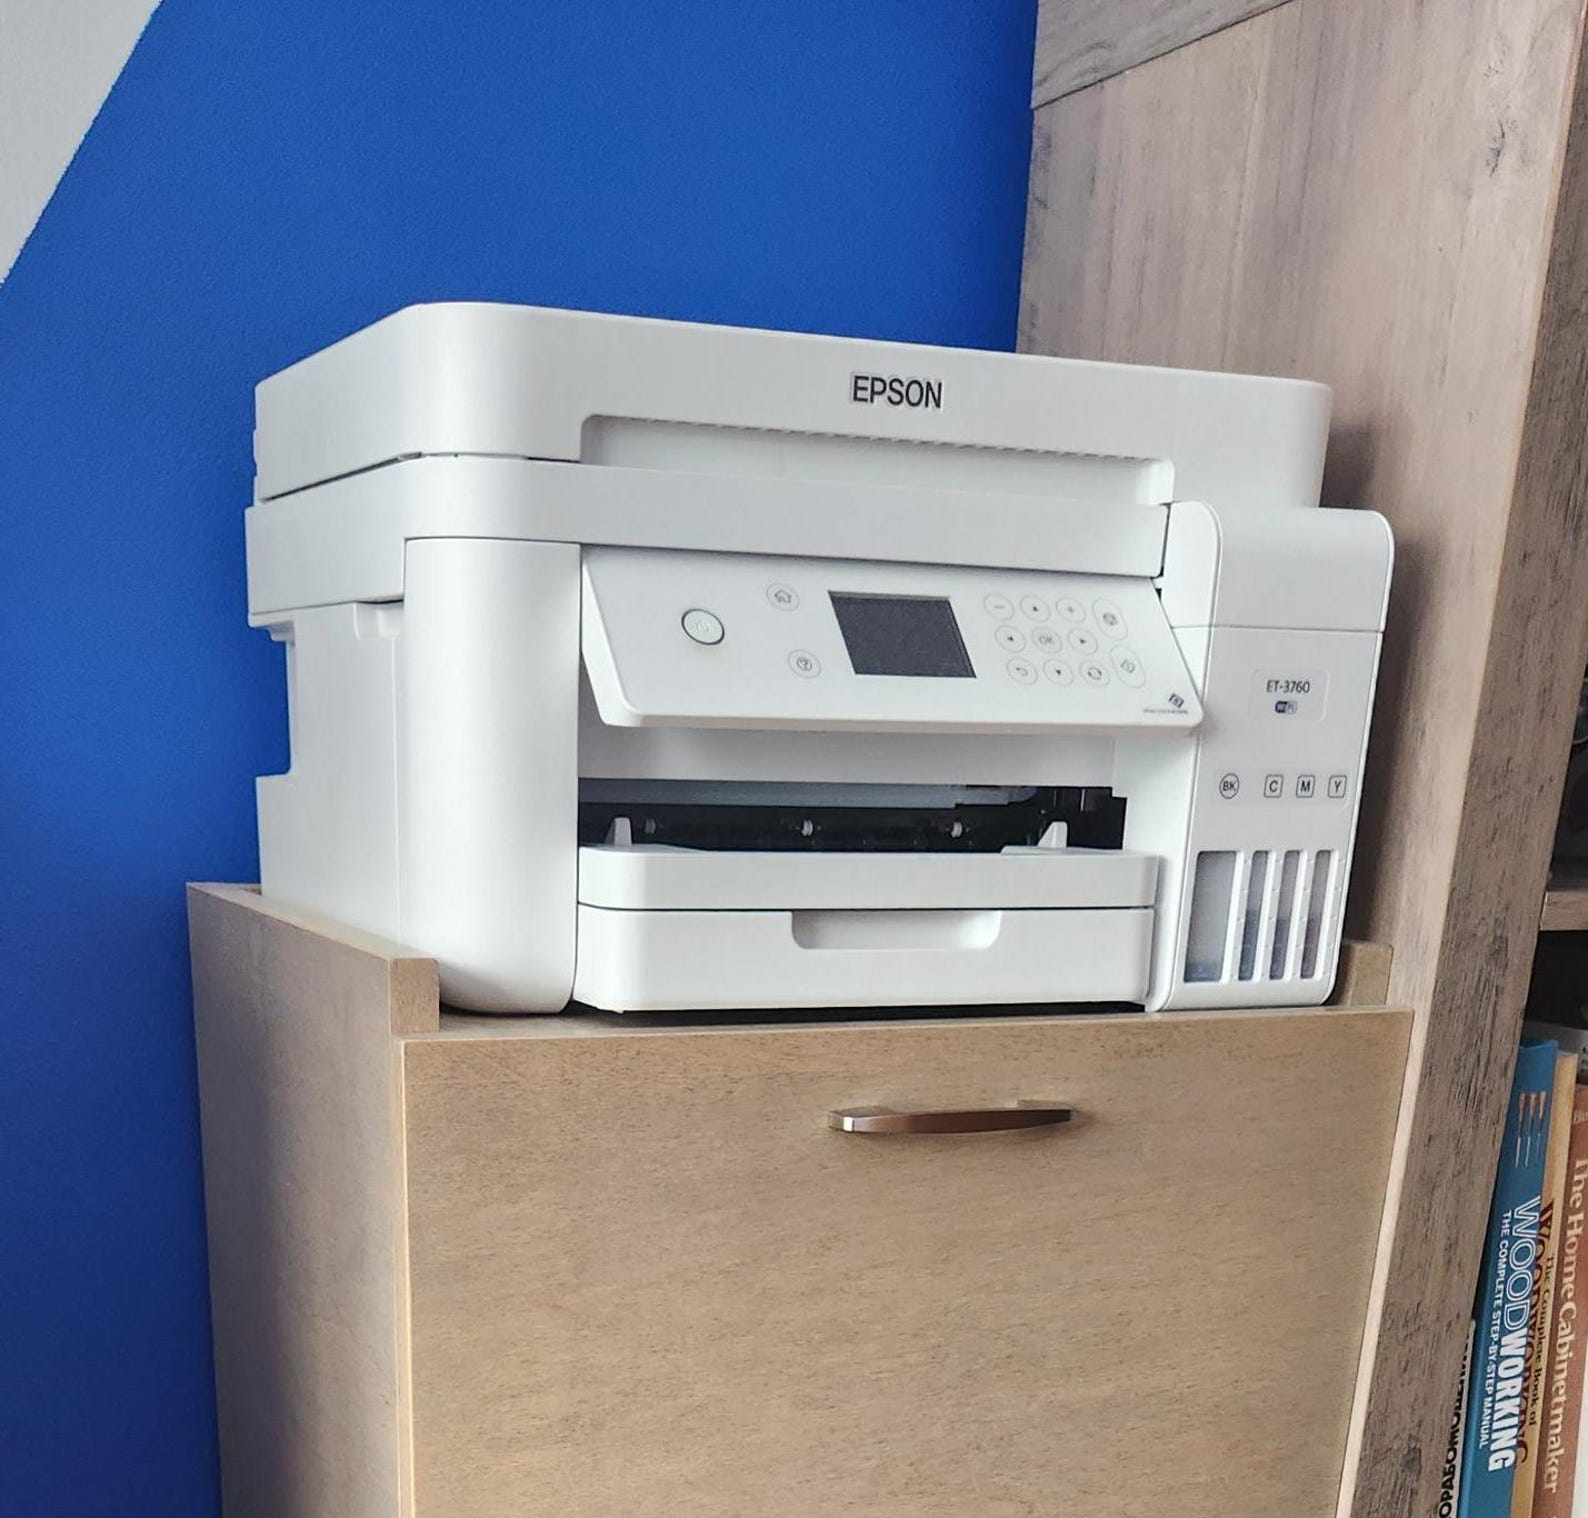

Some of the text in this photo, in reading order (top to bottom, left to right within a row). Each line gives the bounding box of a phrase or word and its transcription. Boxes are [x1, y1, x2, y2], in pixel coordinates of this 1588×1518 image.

[853, 375, 942, 408] EPSON
[1266, 679, 1310, 693] ET-3760
[1222, 780, 1342, 792] BK C M Y
[1569, 1159, 1587, 1208] The
[1560, 1213, 1585, 1300] Home
[1479, 1210, 1512, 1449] THE COMPLETE STEP-BY-STEP MANUAL
[1488, 1195, 1541, 1471] WOODWORKING
[1528, 1254, 1554, 1426] The Complete Book of
[1544, 1301, 1577, 1493] Cabinetmaker
